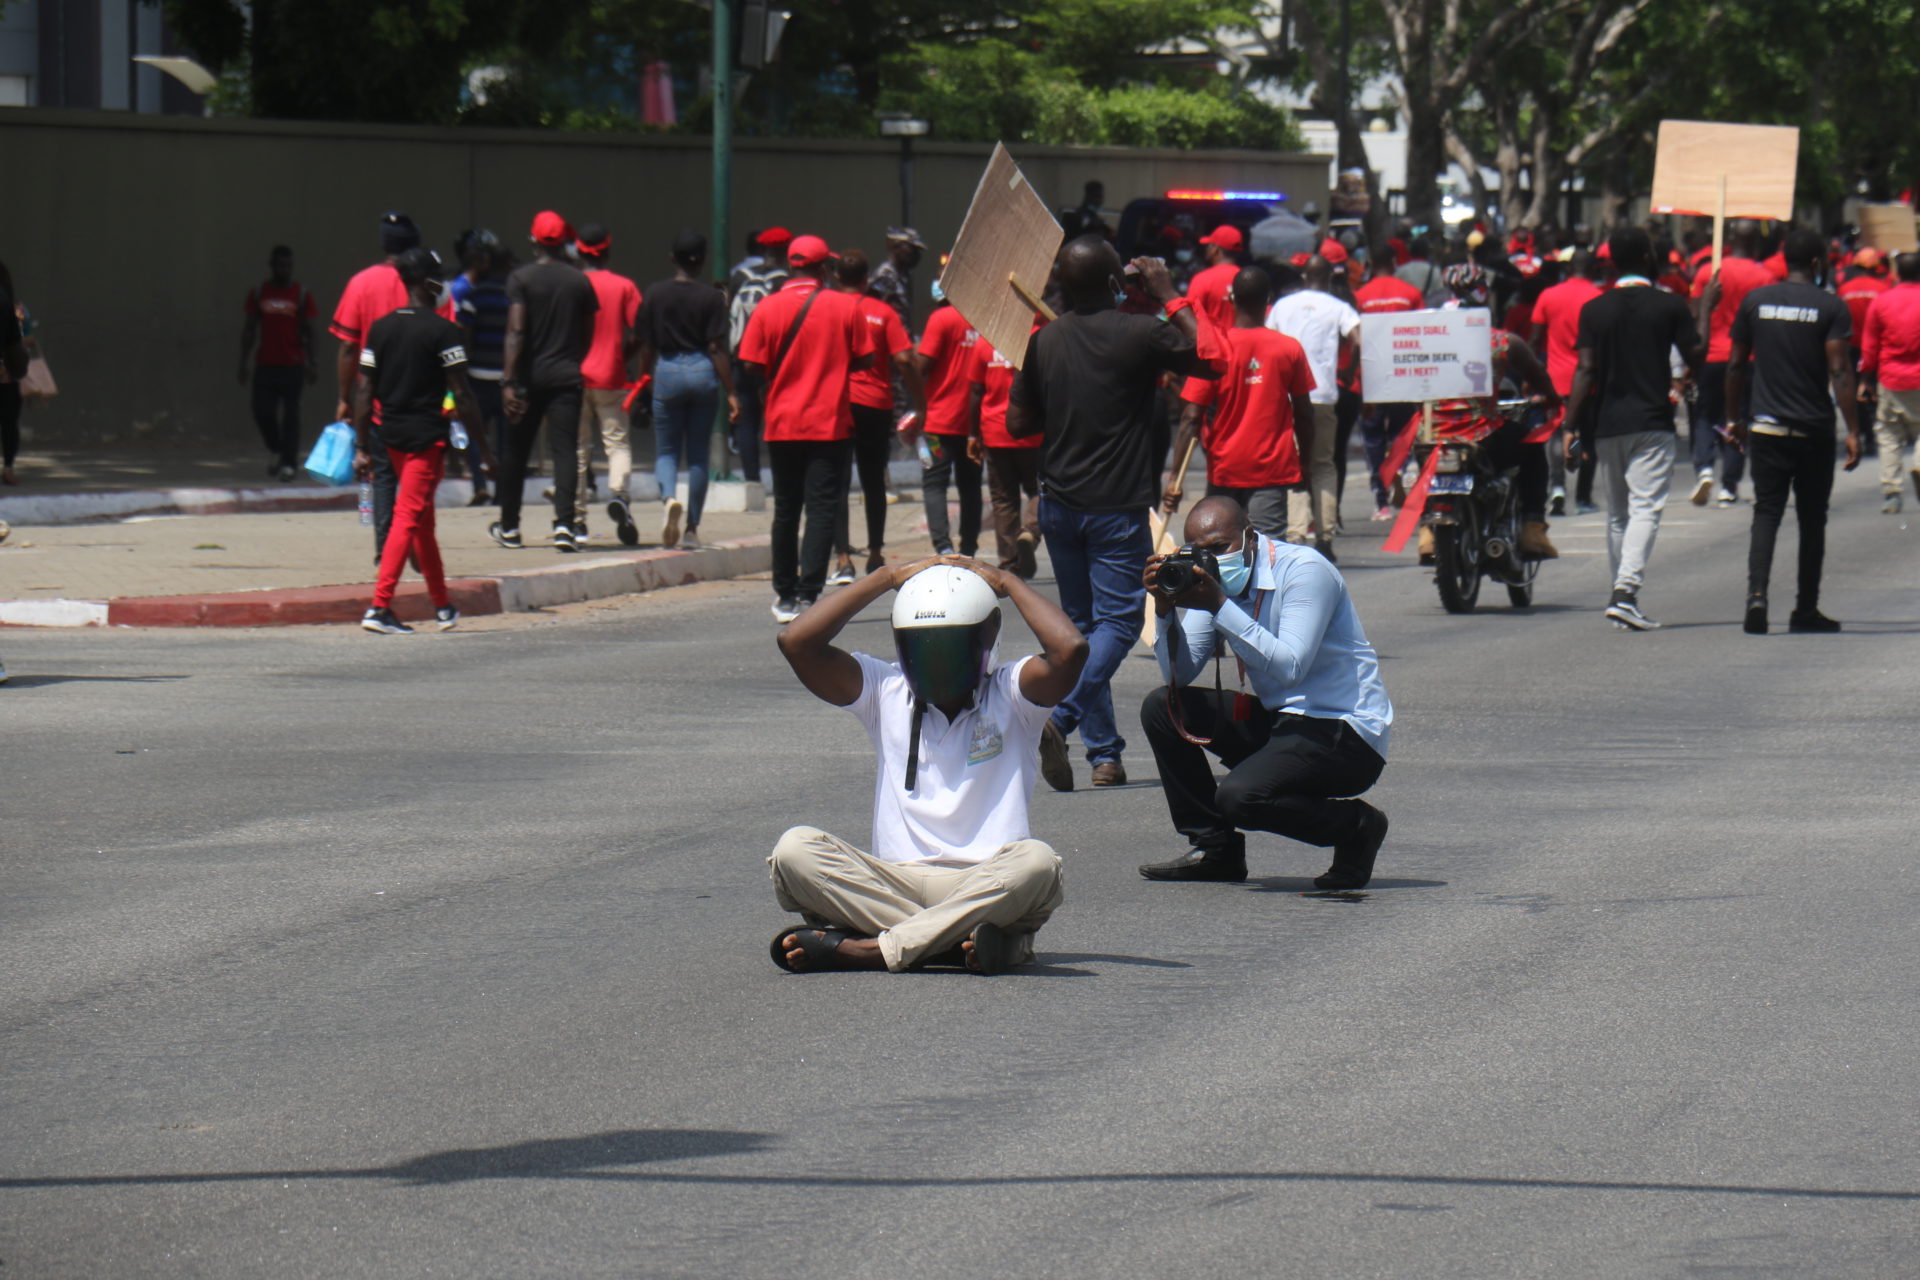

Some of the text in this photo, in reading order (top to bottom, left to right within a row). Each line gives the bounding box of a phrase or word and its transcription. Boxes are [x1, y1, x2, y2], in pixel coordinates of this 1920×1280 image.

[1392, 326, 1421, 336] AHMED
[1393, 354, 1429, 364] ELECTION
[1394, 367, 1407, 377] AM
[1413, 366, 1439, 377] NEXT?
